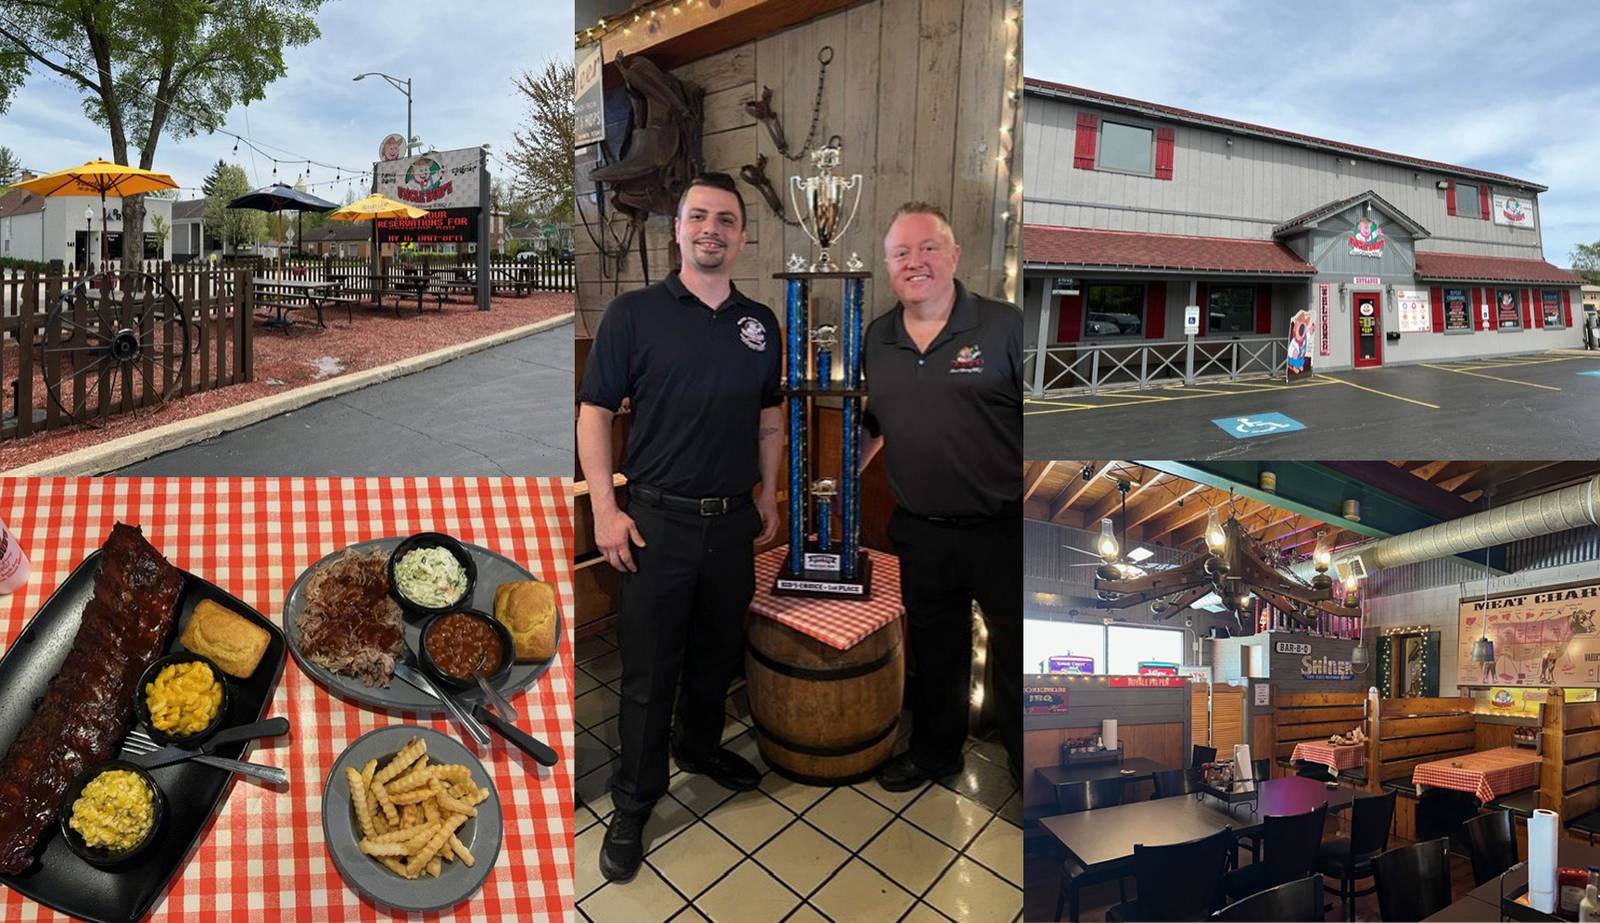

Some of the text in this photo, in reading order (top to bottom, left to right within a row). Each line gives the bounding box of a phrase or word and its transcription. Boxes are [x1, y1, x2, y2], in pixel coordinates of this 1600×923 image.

[447, 217, 468, 226] FOR
[1474, 587, 1600, 611] MEAT CHAR
